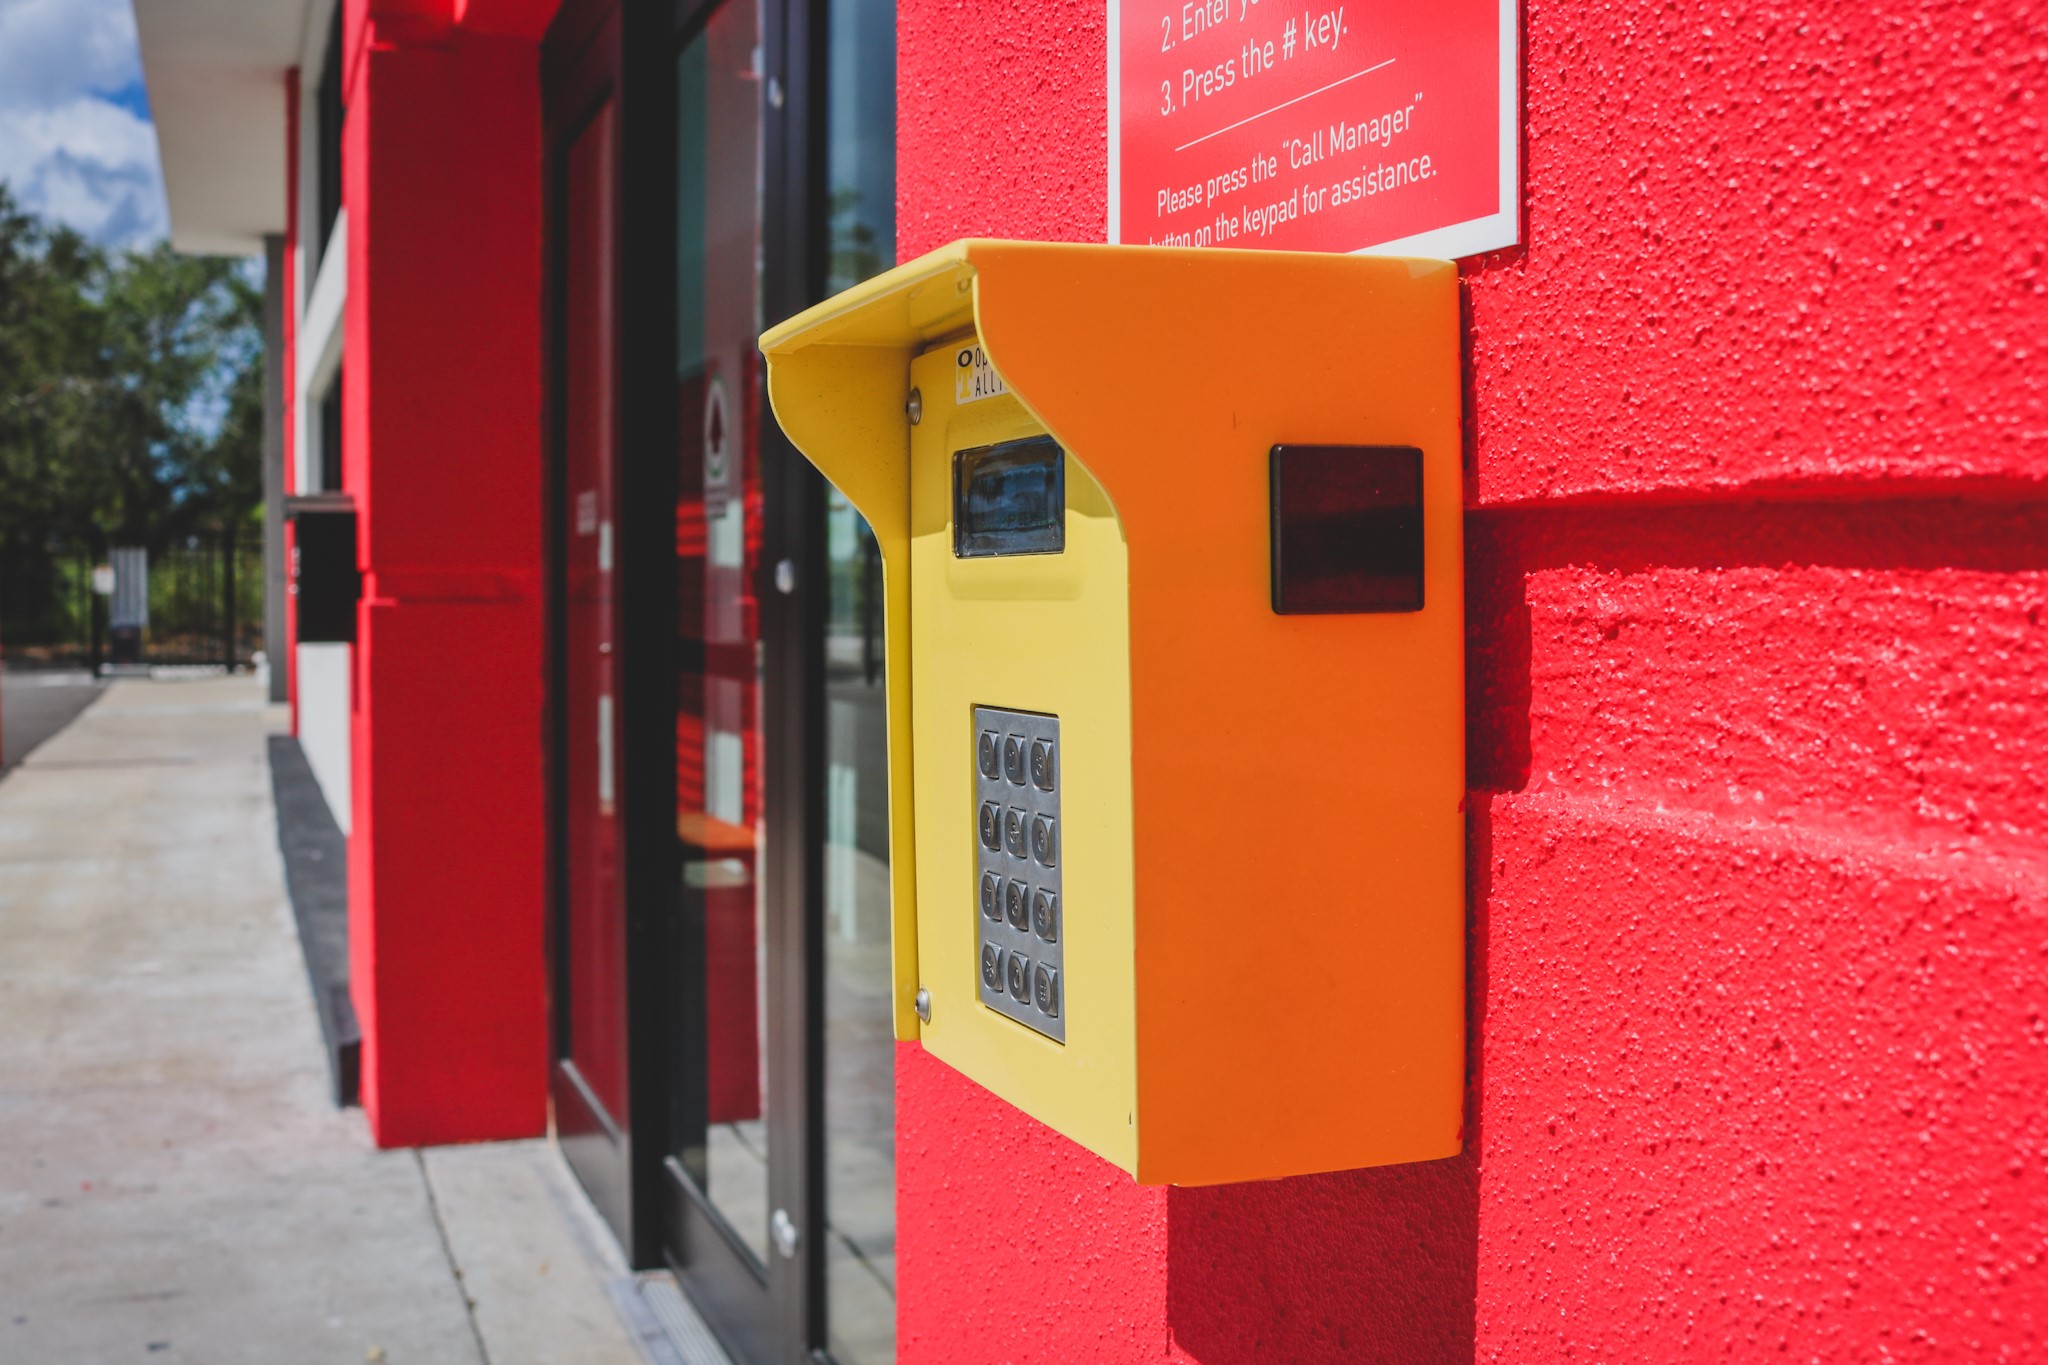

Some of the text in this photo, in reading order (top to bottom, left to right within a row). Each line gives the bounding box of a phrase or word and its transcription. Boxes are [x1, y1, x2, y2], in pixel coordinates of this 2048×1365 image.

[1161, 16, 1176, 53] 2.
[1161, 7, 1348, 116] 3. Press the # key.
[1157, 183, 1203, 217] Please
[1207, 166, 1248, 208] press
[1251, 153, 1278, 183] the
[1194, 225, 1212, 248] on
[1215, 212, 1239, 242] the
[1243, 188, 1298, 236] keypad
[1302, 184, 1327, 216] for
[1331, 154, 1437, 207] assistance.
